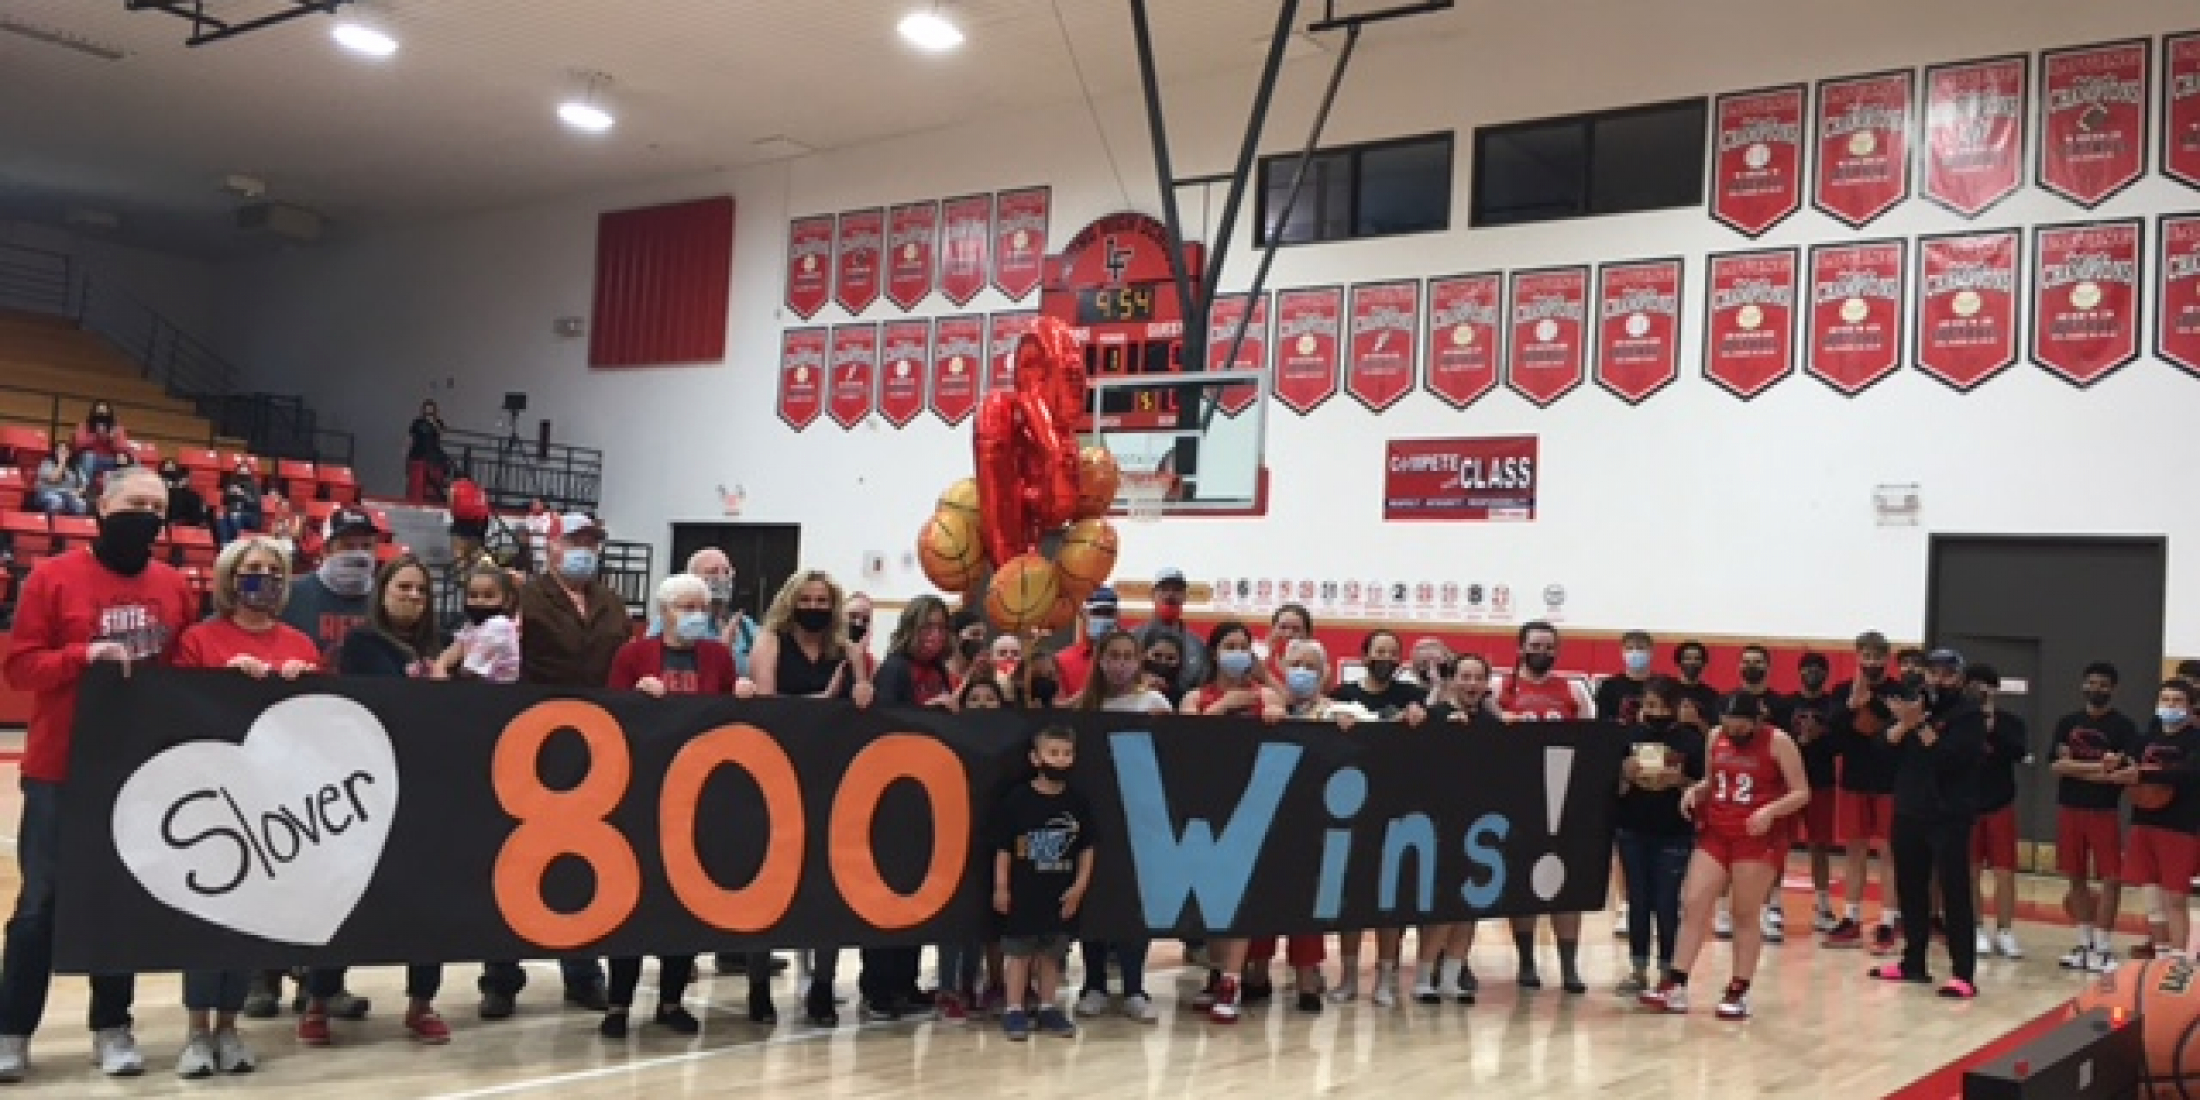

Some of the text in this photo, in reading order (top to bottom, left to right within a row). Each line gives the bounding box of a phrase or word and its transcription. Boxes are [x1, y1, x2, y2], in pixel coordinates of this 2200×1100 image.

[1460, 456, 1532, 490] CLASS
[491, 697, 1576, 950] 800 Wins!
[1715, 770, 1753, 804] 12
[161, 769, 375, 896] Slover
